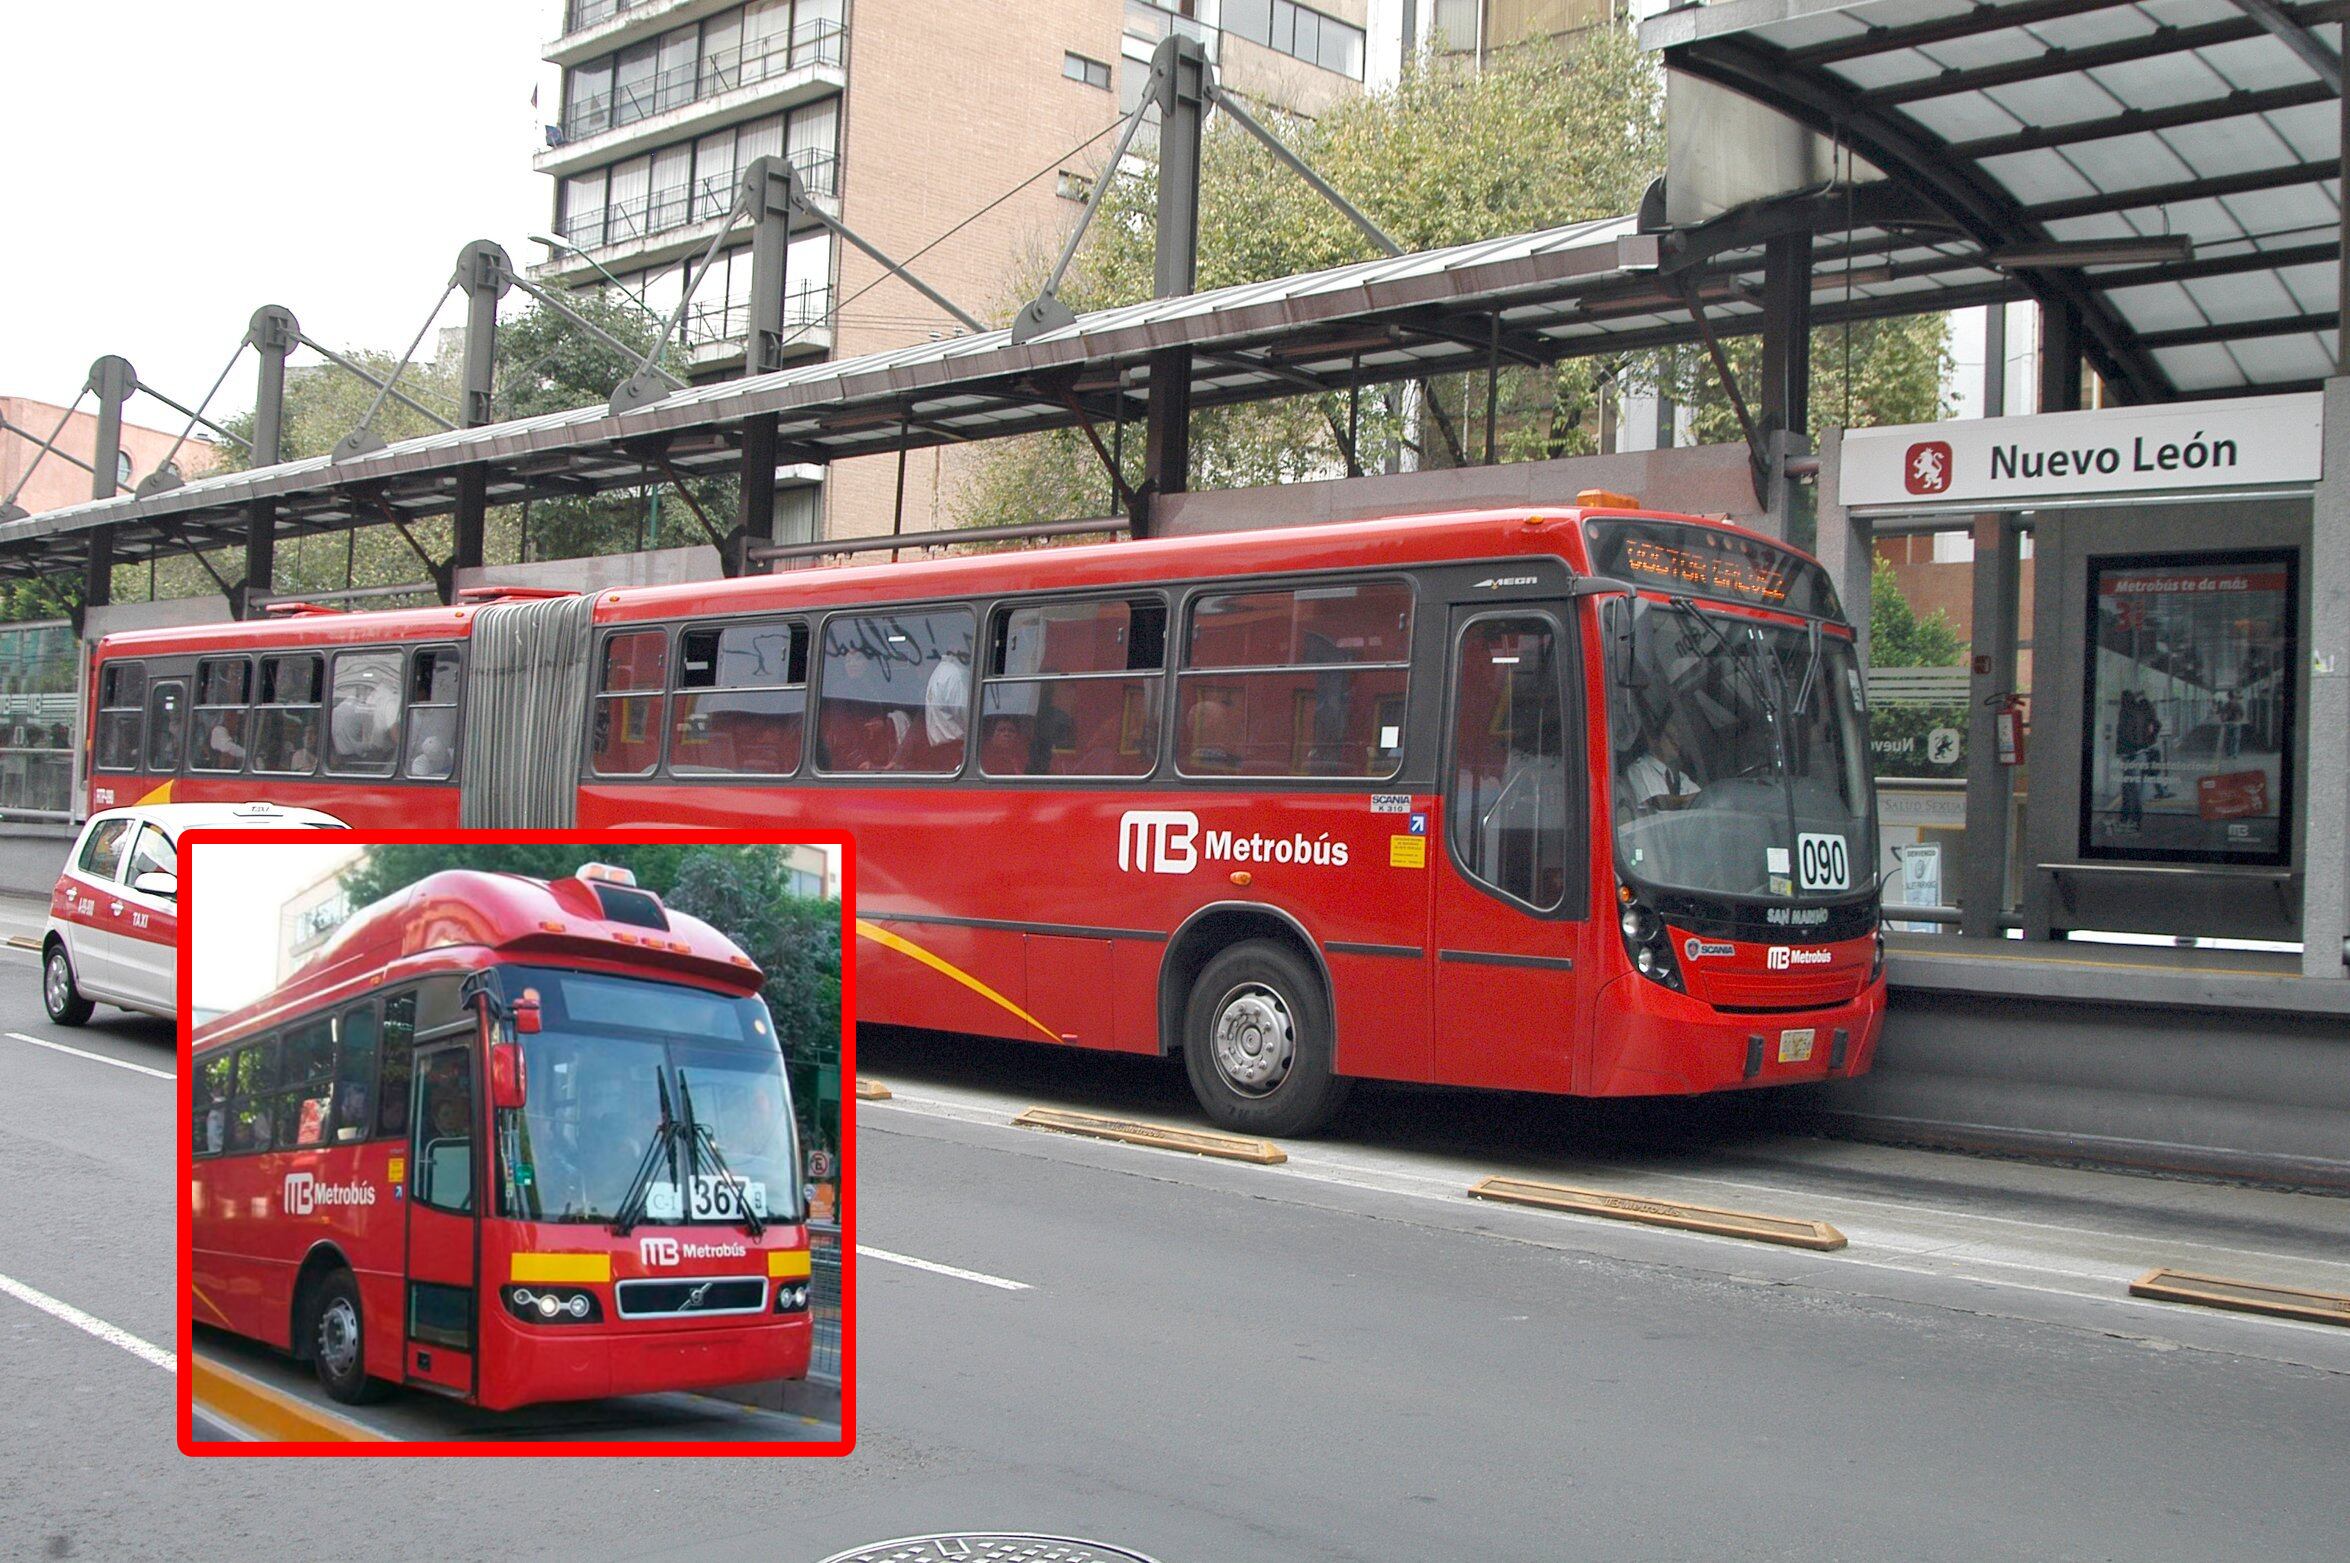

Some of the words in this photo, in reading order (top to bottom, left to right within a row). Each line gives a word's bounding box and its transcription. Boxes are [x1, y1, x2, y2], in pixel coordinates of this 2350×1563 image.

[1990, 444, 2121, 480] Nuevo
[2133, 430, 2238, 472] León
[2114, 578, 2179, 593] Metrobús
[2181, 579, 2196, 592] te
[2198, 577, 2216, 591] da
[2218, 575, 2249, 590] más
[1372, 796, 1410, 804] SCANIA
[1118, 810, 1199, 875] MB
[1204, 830, 1349, 867] Metrobús
[1802, 839, 1846, 886] 090
[132, 911, 149, 929] TAXI
[1766, 907, 1790, 925] SAN
[1701, 945, 1733, 954] SCANIA
[1766, 946, 1791, 970] MB
[1790, 948, 1832, 965] Metrobús
[284, 1172, 314, 1215] MB
[314, 1180, 375, 1206] Metrobús
[696, 1179, 746, 1215] 367
[640, 1237, 679, 1266] MB
[682, 1242, 746, 1259] Metrobús
